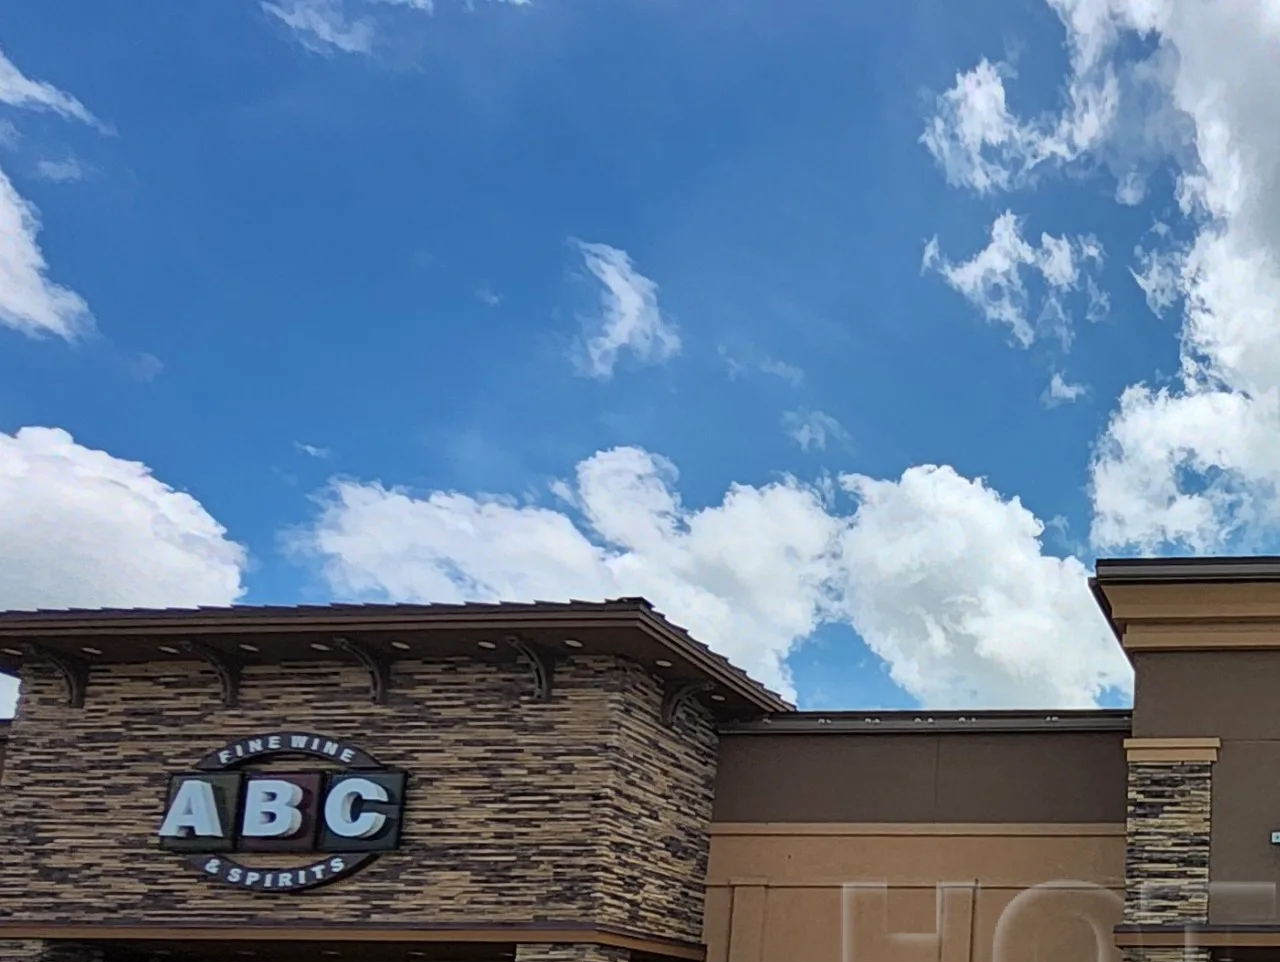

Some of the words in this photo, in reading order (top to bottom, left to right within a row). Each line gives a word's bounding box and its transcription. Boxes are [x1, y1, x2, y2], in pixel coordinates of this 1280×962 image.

[218, 735, 283, 764] FINE
[290, 735, 356, 763] WINE
[158, 778, 389, 839] ABC
[204, 858, 220, 874] &
[227, 857, 345, 887] SPIRITS
